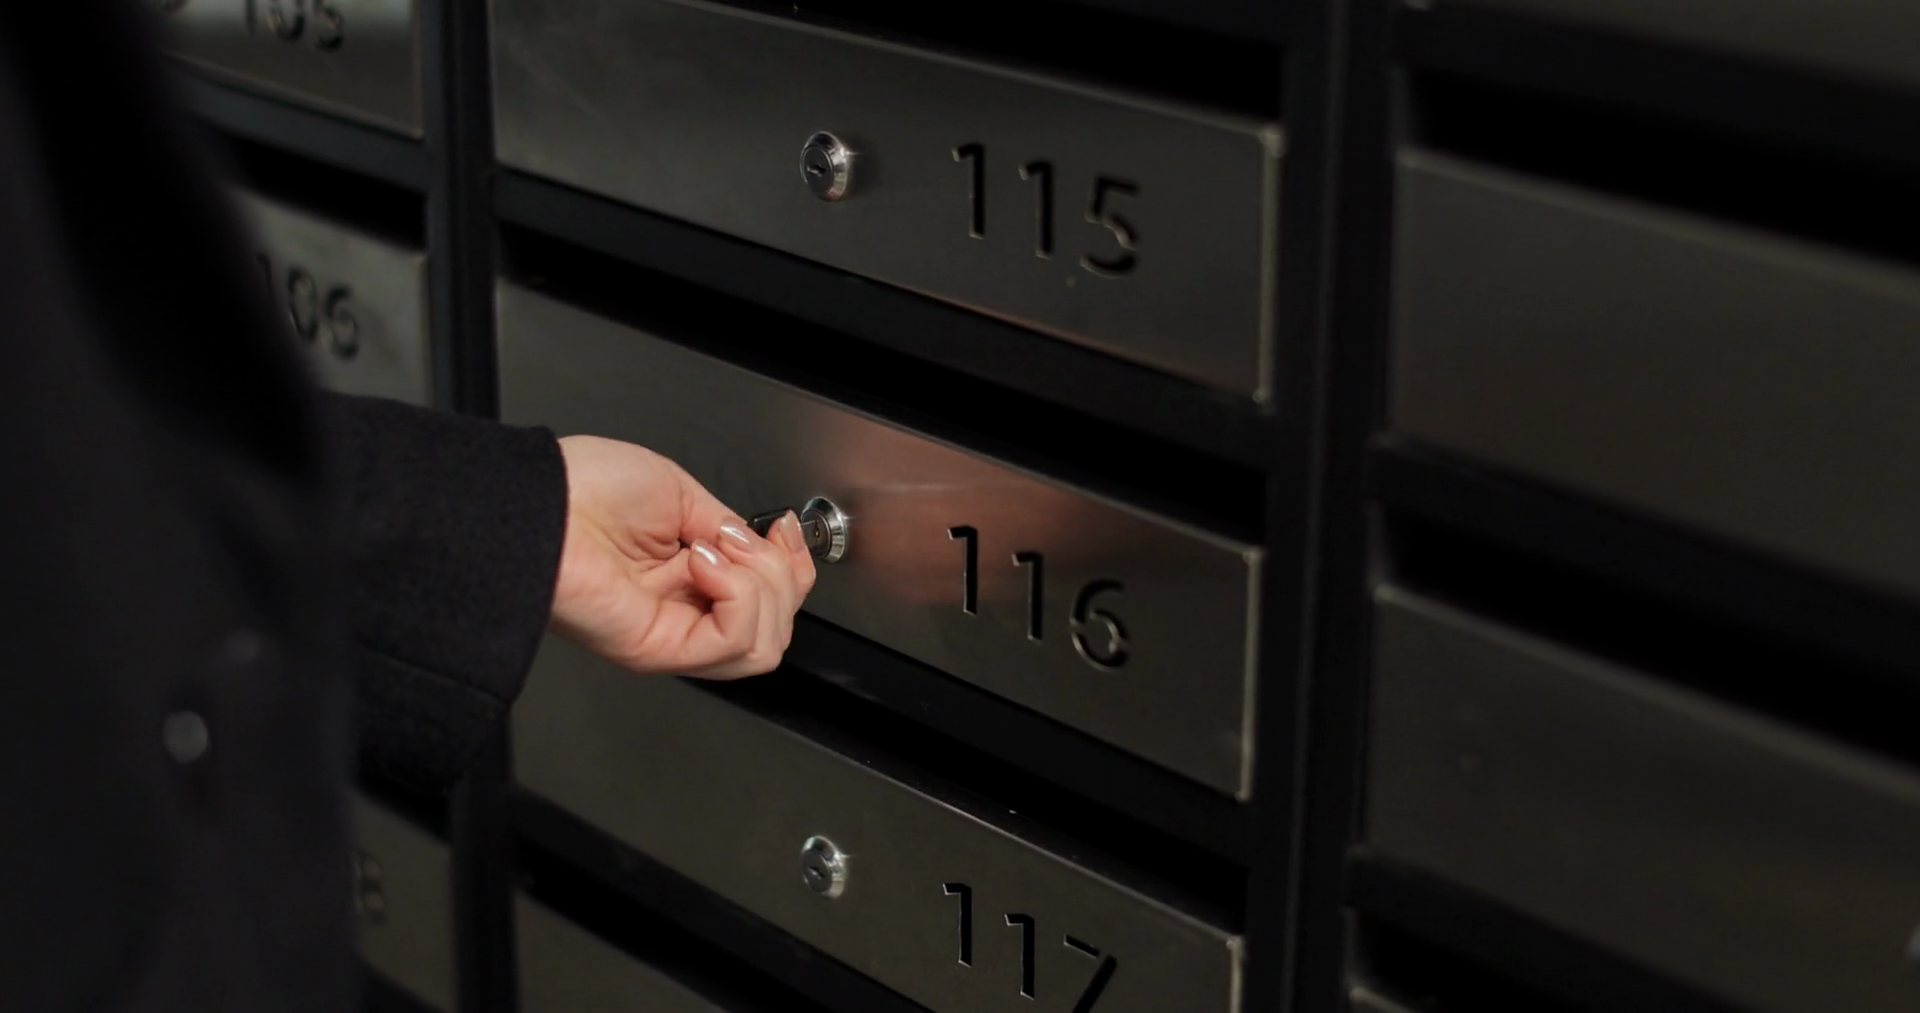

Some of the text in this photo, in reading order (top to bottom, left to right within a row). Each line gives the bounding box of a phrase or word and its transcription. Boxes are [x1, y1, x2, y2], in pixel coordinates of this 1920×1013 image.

[952, 144, 1138, 277] 115
[947, 526, 1128, 672] 116
[942, 883, 1117, 1013] 117
